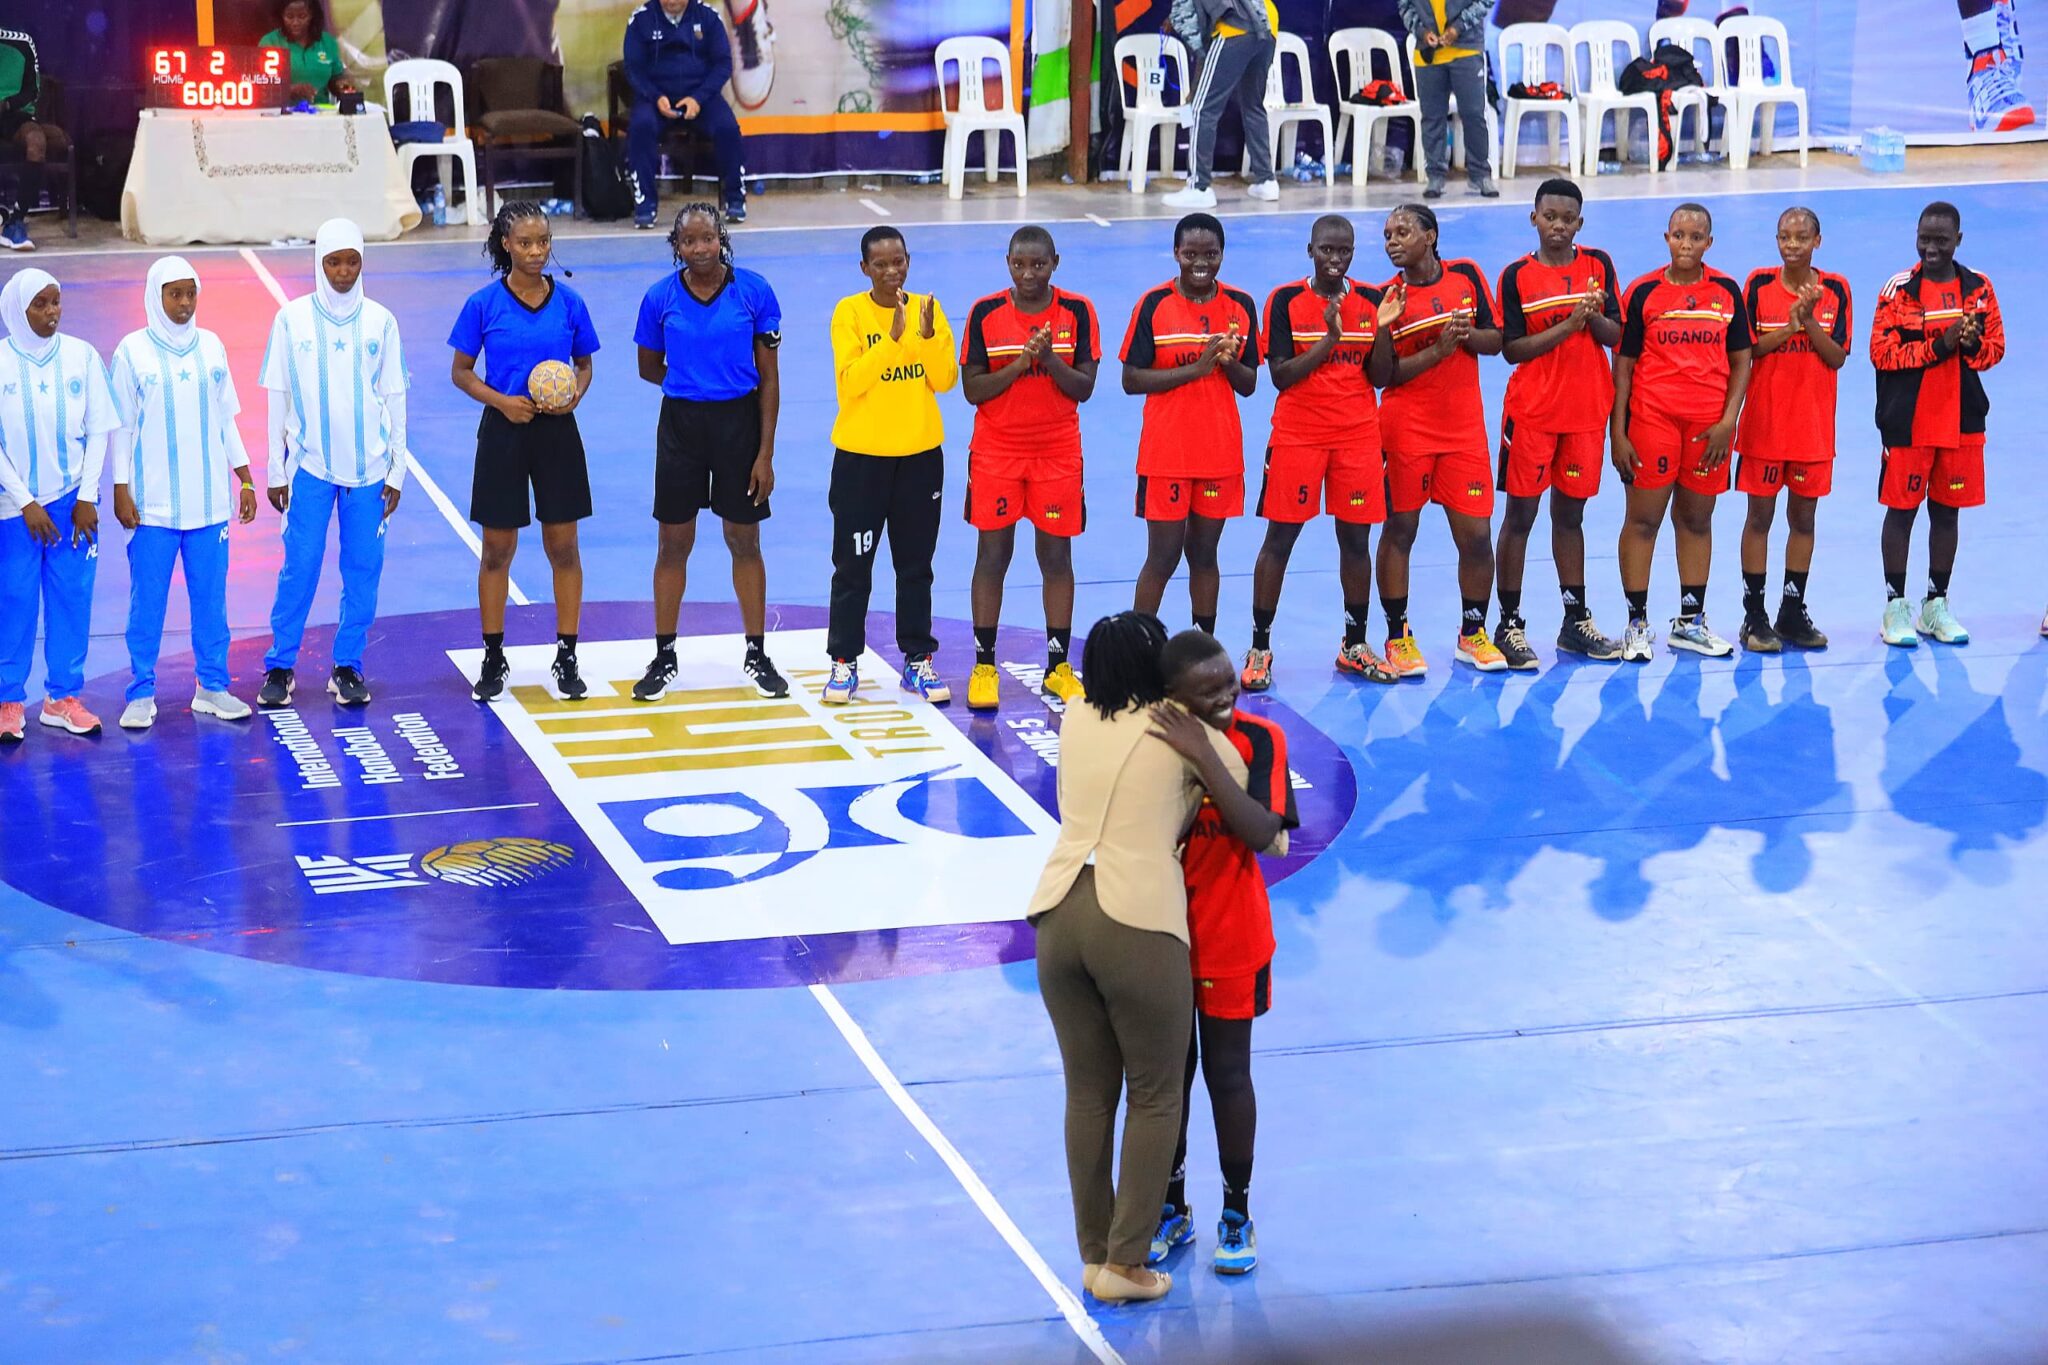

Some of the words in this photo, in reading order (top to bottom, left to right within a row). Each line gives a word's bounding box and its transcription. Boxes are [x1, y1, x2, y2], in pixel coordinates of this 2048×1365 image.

[155, 51, 186, 74] 67
[210, 51, 225, 75] 2
[264, 51, 279, 75] 2
[153, 74, 184, 84] HOME
[1150, 73, 1161, 84] B
[183, 81, 253, 106] 60:00
[1562, 276, 1571, 295] 7
[1657, 330, 1721, 344] UGANDA
[881, 363, 925, 381] GAND
[1536, 465, 1546, 483] 7
[1657, 455, 1668, 474] 9
[1422, 475, 1430, 491] 6
[1762, 465, 1778, 485] 10
[1906, 474, 1922, 492] 13
[1170, 483, 1180, 503] 3
[1298, 484, 1308, 504] 5
[996, 497, 1008, 516] 2
[853, 530, 873, 556] 19
[508, 679, 855, 779] IHF
[1006, 717, 1045, 730] 5
[257, 708, 342, 789] International
[331, 727, 404, 785] Handball
[392, 712, 465, 780] Federation
[294, 853, 431, 894] IHF
